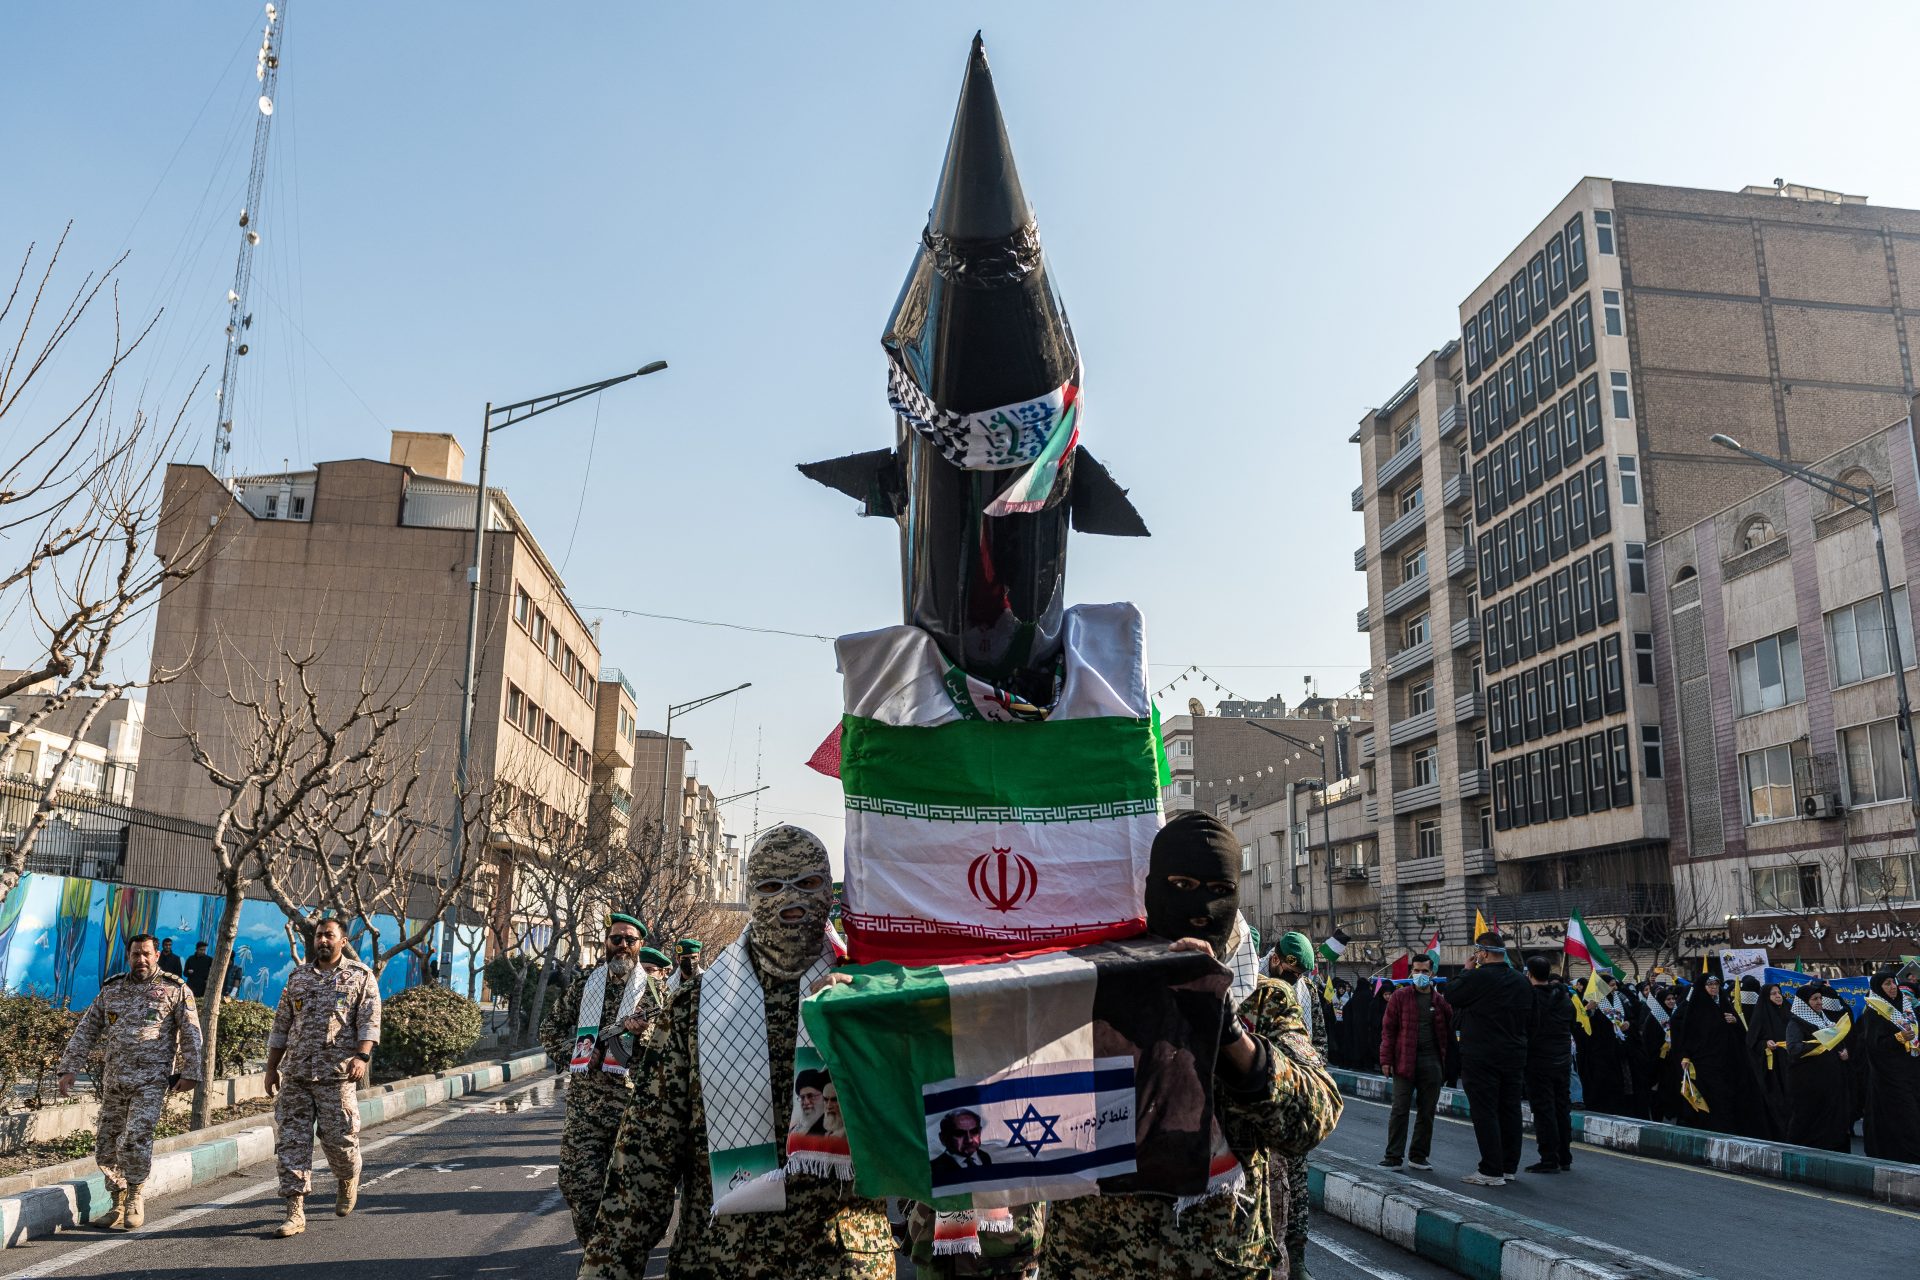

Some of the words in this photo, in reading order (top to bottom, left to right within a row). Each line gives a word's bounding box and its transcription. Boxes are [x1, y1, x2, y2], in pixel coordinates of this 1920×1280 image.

[1836, 924, 1866, 945] طبیعی
[1866, 922, 1891, 943] الیاف
[1109, 1106, 1129, 1123] غلط
